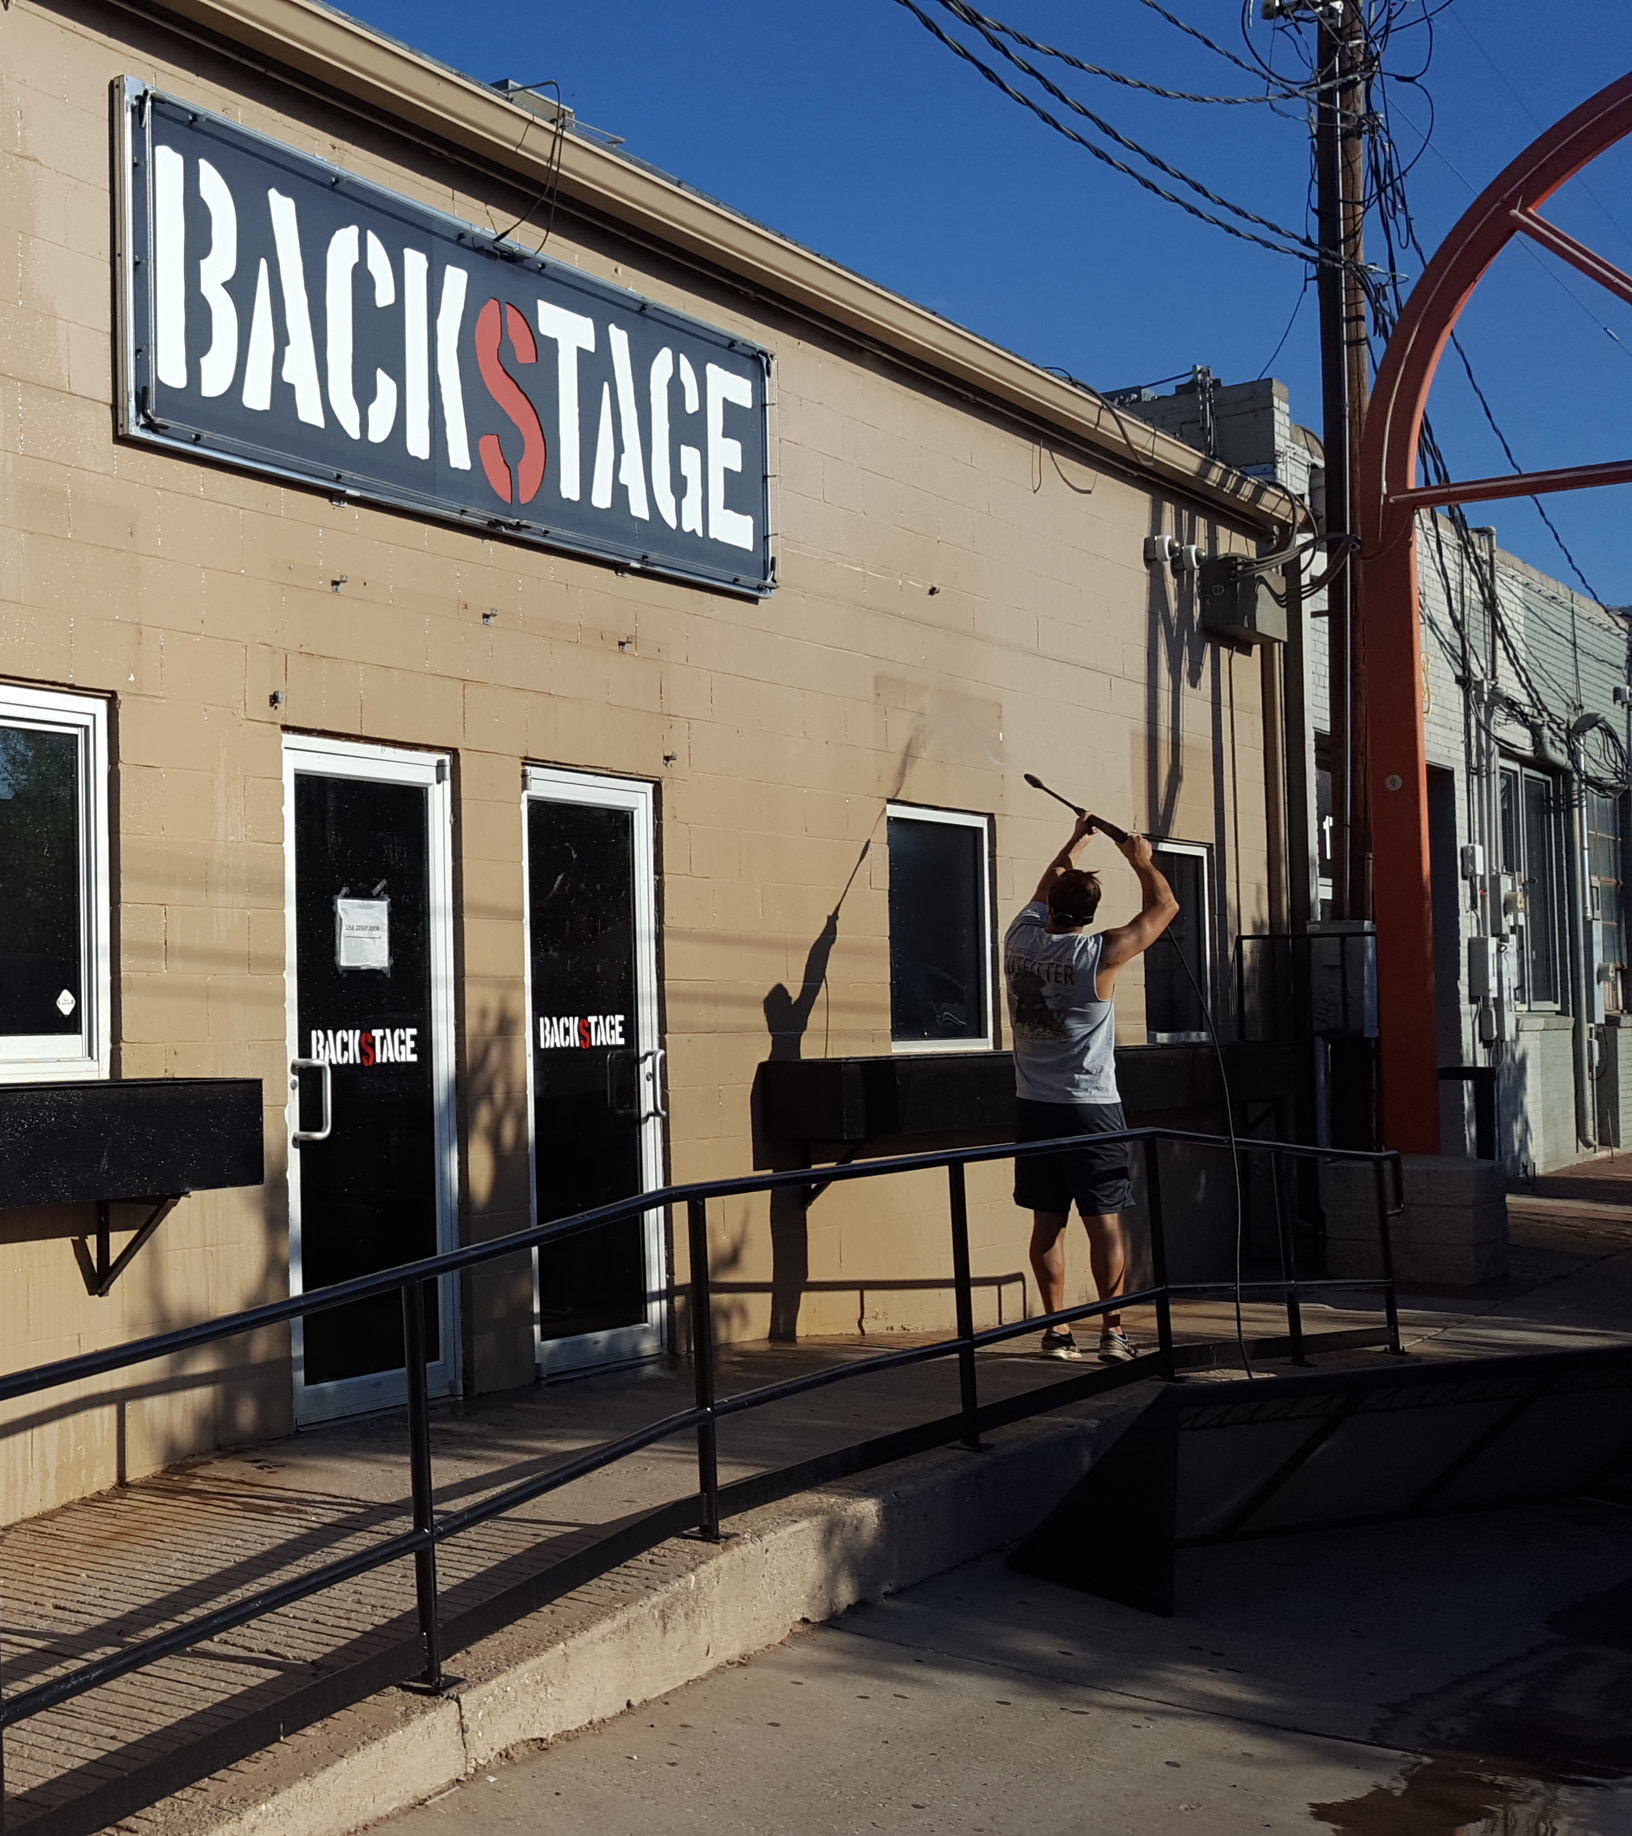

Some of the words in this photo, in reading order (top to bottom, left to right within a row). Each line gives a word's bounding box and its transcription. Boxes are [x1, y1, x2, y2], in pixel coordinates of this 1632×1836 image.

[154, 145, 753, 551] BACKSTAGE
[311, 1028, 417, 1066] BACKSTAGE
[539, 1014, 625, 1049] BACKSTAGE
